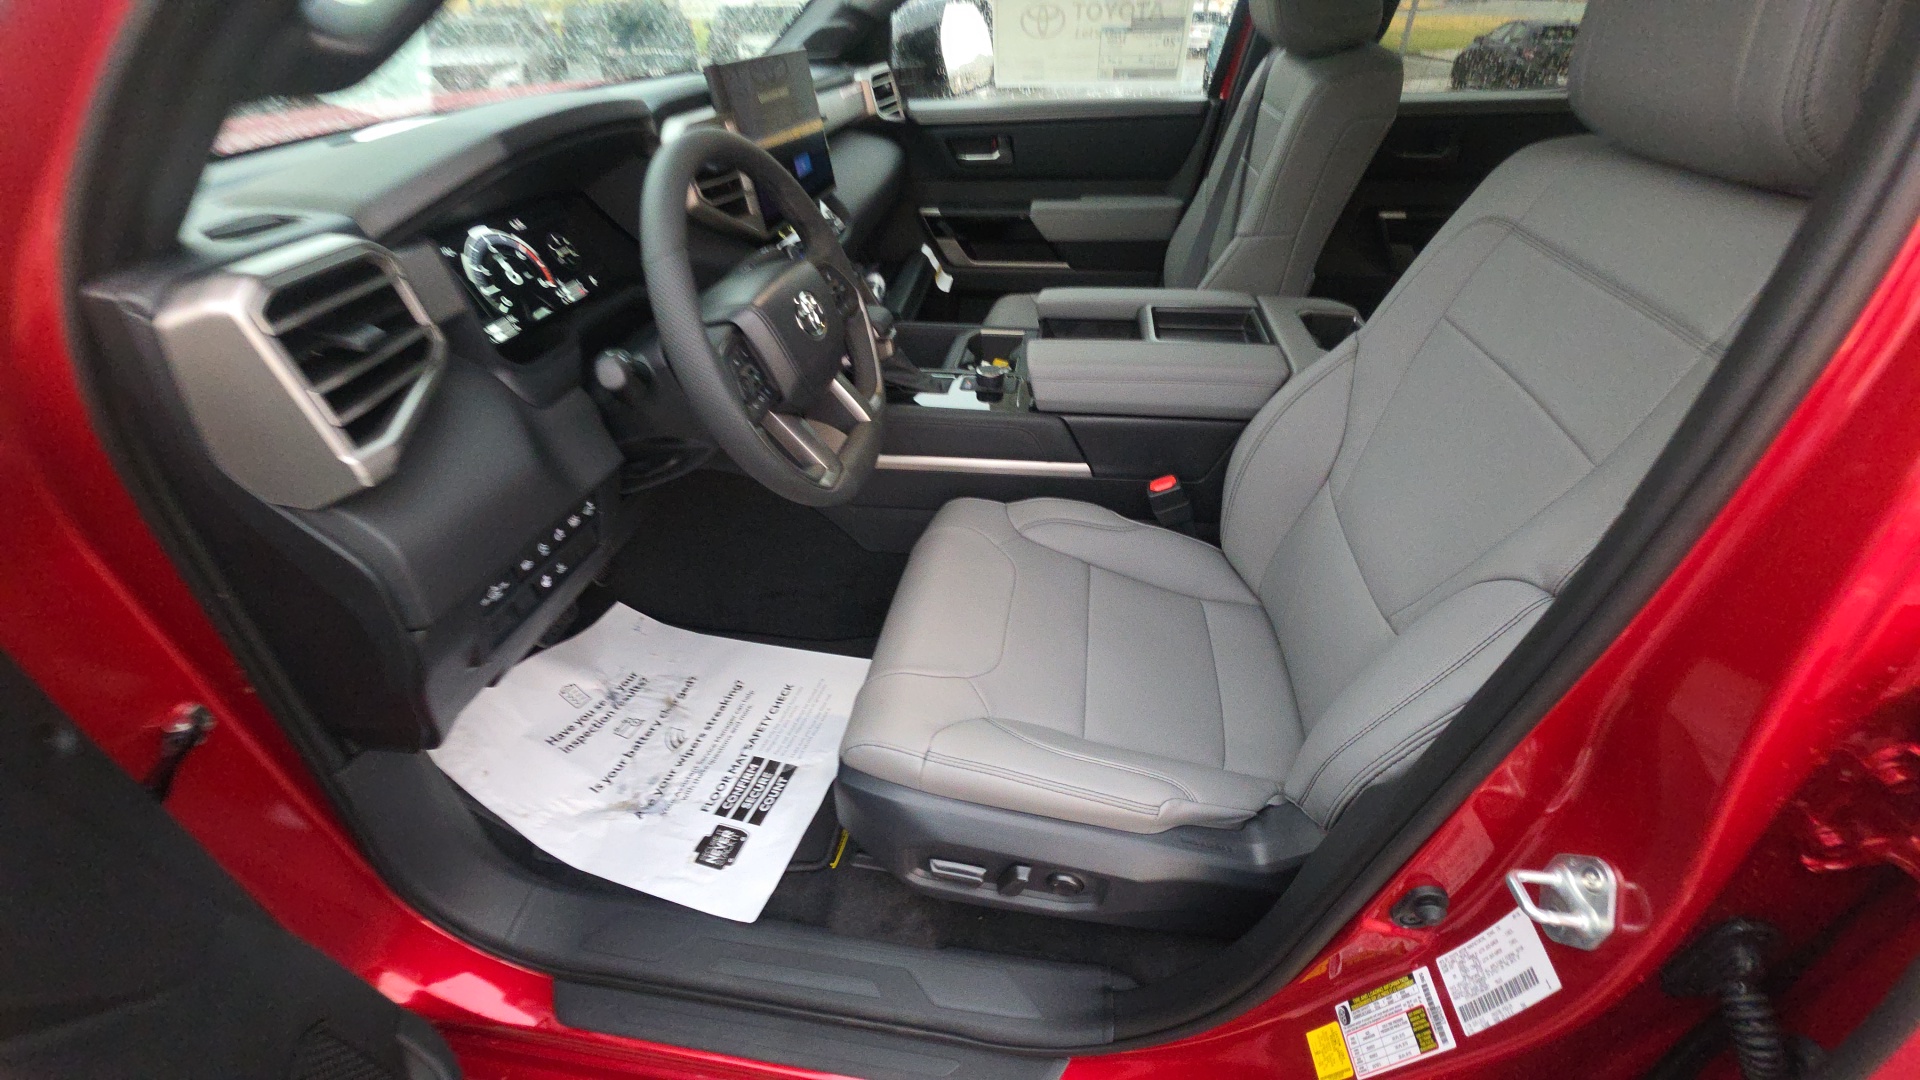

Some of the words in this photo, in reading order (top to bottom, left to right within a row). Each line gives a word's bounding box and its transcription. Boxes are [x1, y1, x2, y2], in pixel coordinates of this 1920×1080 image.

[1073, 1, 1165, 21] TOYOTA
[544, 723, 576, 747] Have
[574, 707, 595, 729] you
[616, 671, 638, 694] your
[558, 706, 615, 754] inspection
[588, 782, 603, 794] Is
[603, 758, 627, 785] your
[622, 718, 660, 758] battery
[653, 767, 676, 795] your
[673, 731, 706, 766] wipers
[702, 679, 744, 731] streaking?
[700, 774, 732, 812] FLOOR
[728, 752, 748, 774] MAT
[744, 714, 771, 750] SAFETY
[768, 682, 794, 715] CHECK
[722, 762, 759, 810] CONFIRM
[741, 771, 773, 809] SECURE
[758, 776, 788, 812] COUNT
[704, 829, 734, 864] NEVER
